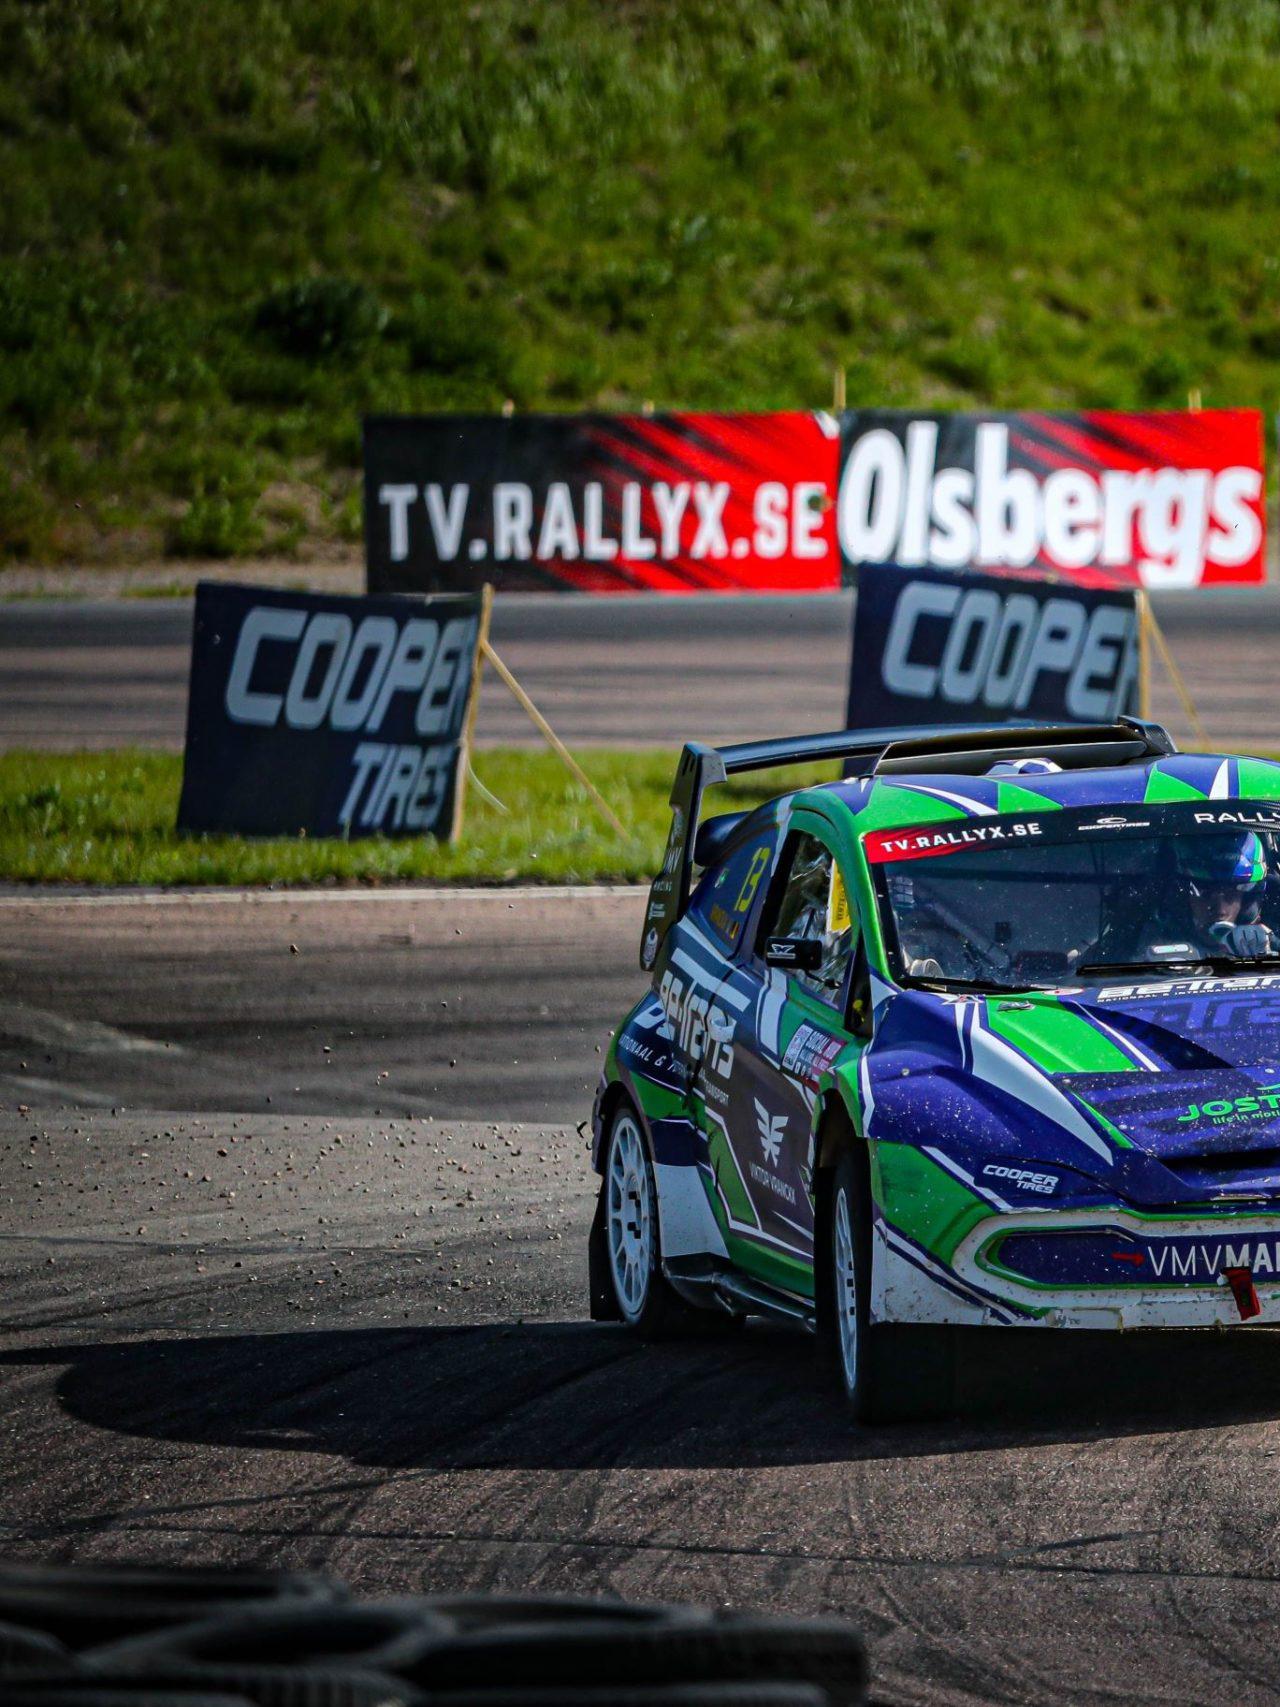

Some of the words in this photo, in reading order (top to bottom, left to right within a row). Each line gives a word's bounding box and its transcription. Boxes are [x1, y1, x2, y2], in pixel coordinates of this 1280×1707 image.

[837, 419, 1264, 589] Olsbergs
[378, 481, 829, 562] TV.RALLYX.SE
[880, 823, 1043, 852] TV.RALLYX.SE
[982, 1164, 1060, 1187] COOPER
[1016, 1180, 1055, 1194] TIRES
